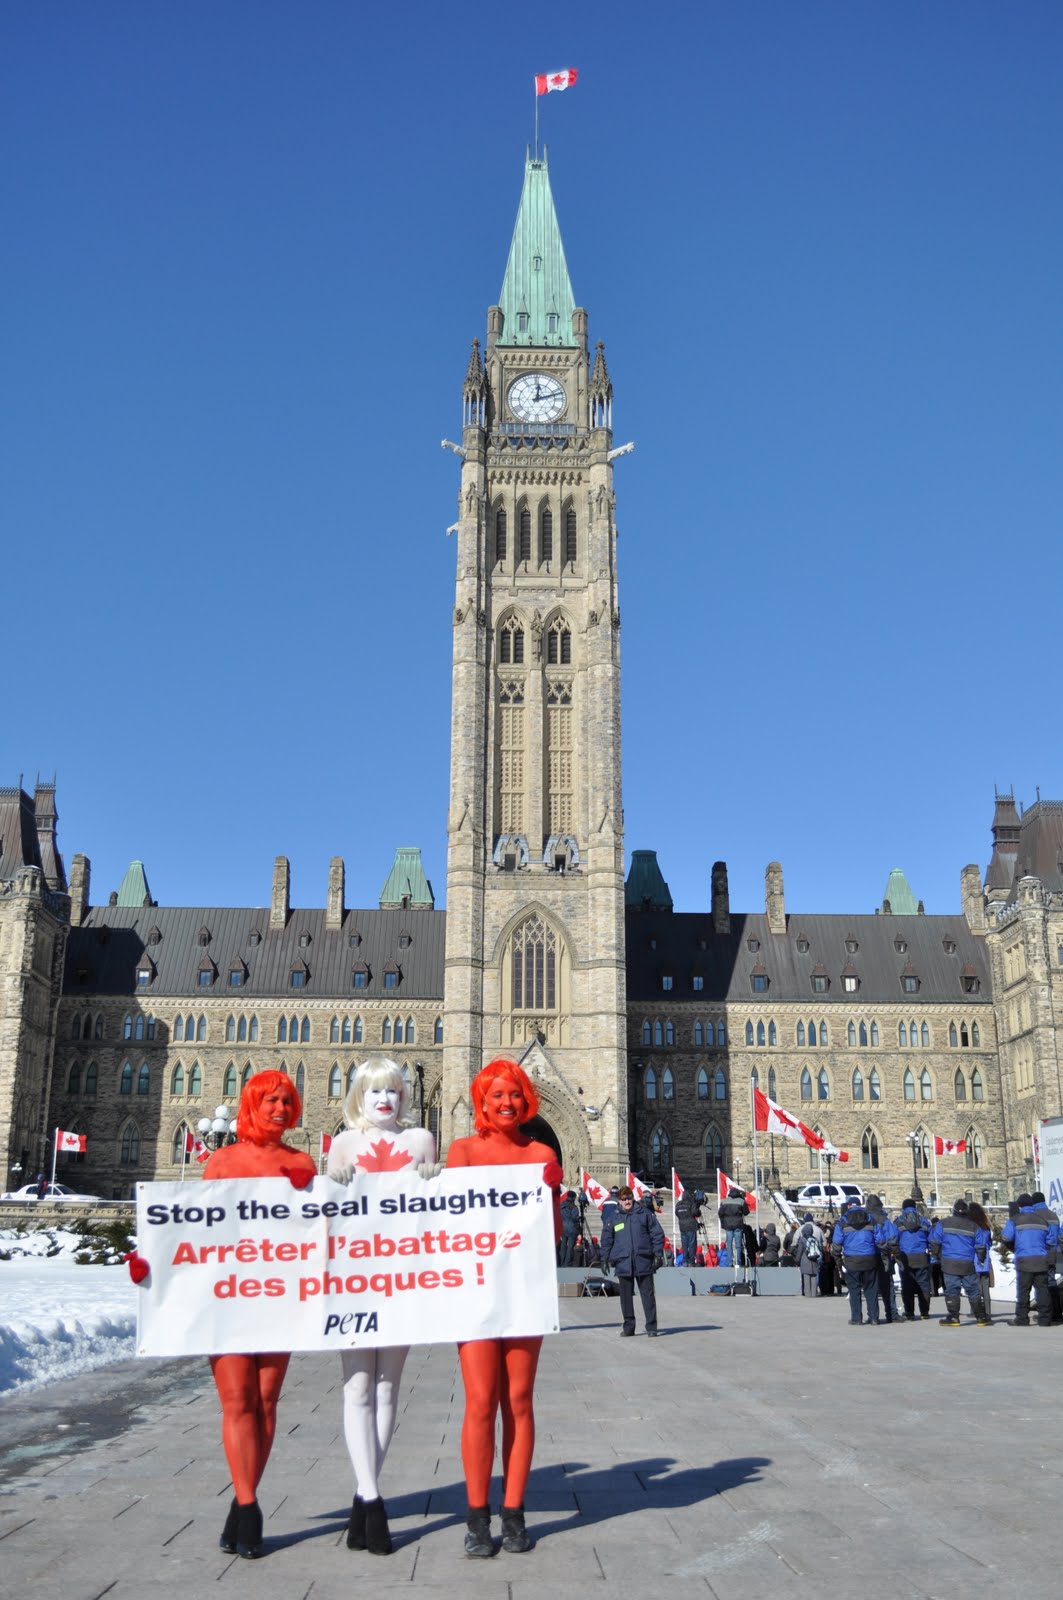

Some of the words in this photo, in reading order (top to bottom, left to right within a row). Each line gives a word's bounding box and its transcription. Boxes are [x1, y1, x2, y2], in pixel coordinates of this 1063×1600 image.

[147, 1204, 226, 1227] Stop
[237, 1199, 290, 1221] the
[302, 1195, 368, 1219] seal
[380, 1185, 543, 1215] slaughter!
[172, 1237, 317, 1265] Arrêter
[213, 1274, 286, 1299] des
[299, 1265, 464, 1302] phoques
[476, 1262, 485, 1286] !
